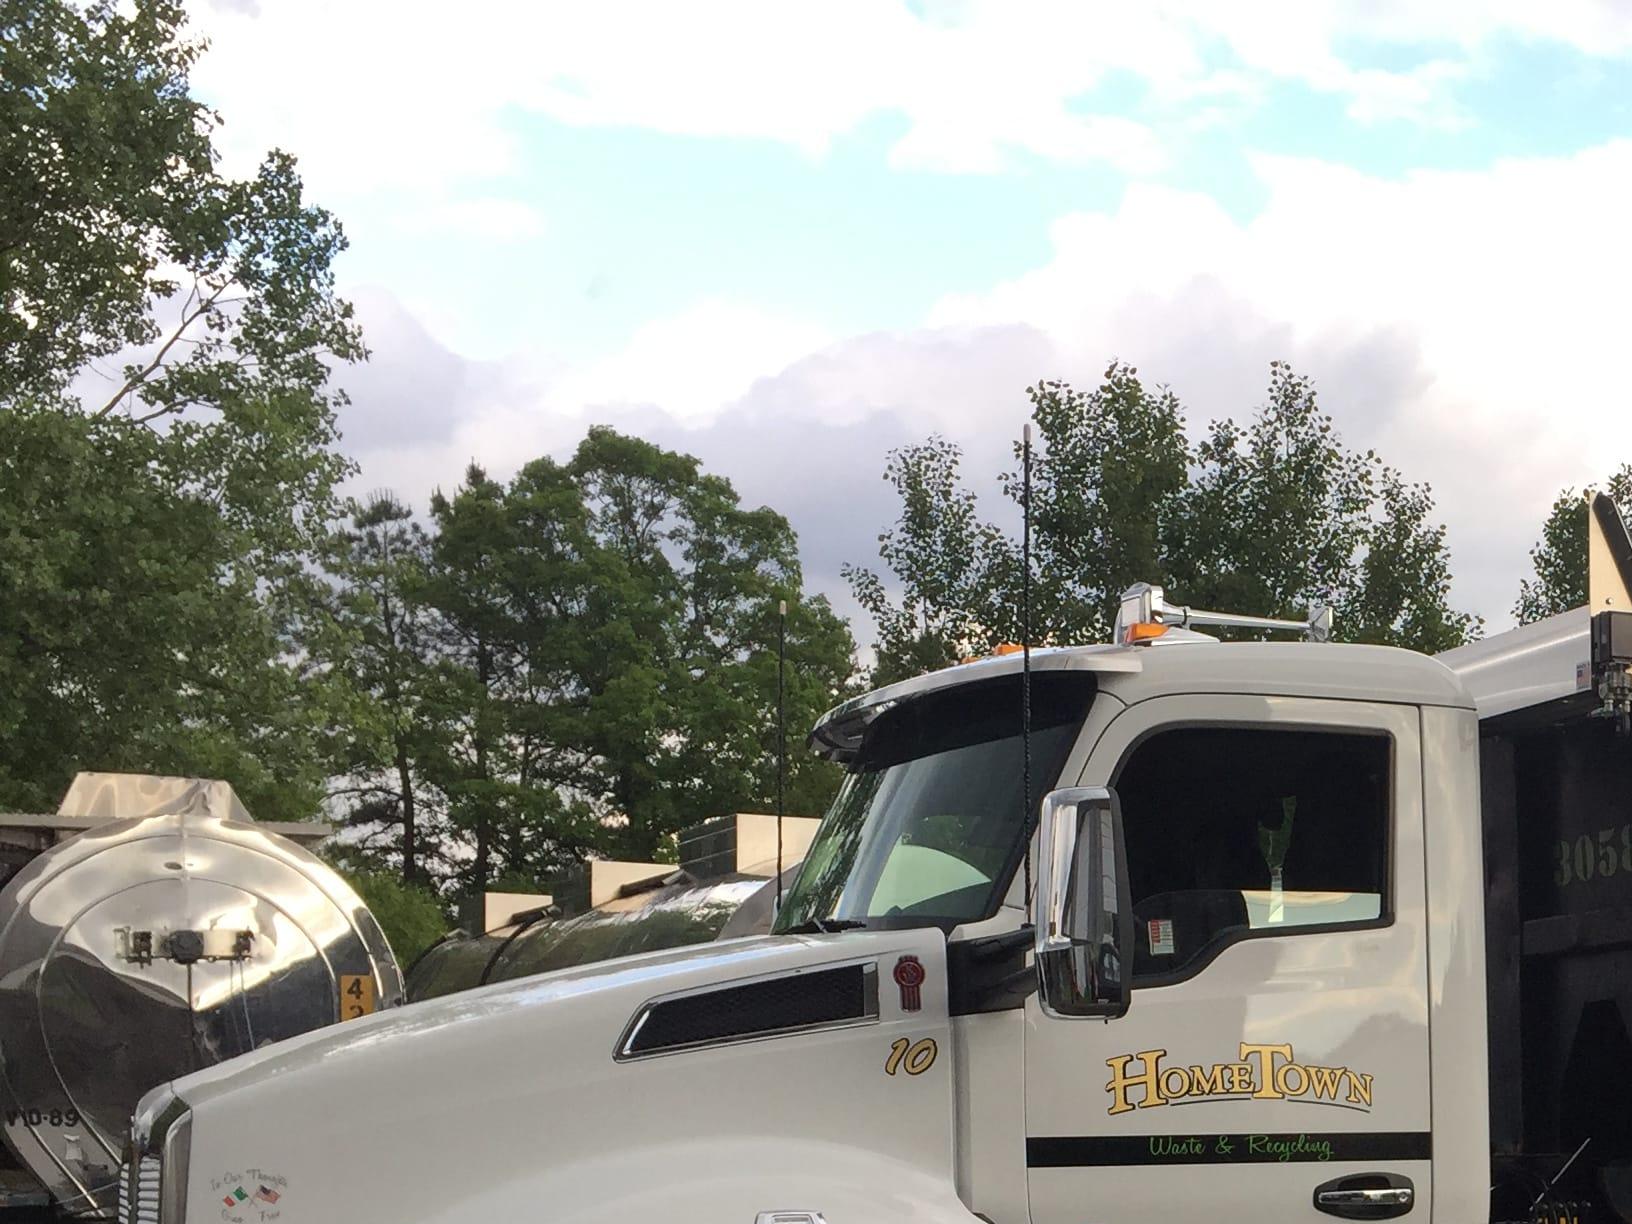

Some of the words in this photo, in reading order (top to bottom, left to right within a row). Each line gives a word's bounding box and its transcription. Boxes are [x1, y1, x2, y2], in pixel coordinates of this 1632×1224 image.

[885, 1037, 938, 1076] 10
[1150, 1136, 1205, 1157] Waste
[1215, 1135, 1234, 1155] &
[1245, 1134, 1335, 1162] Recycling
